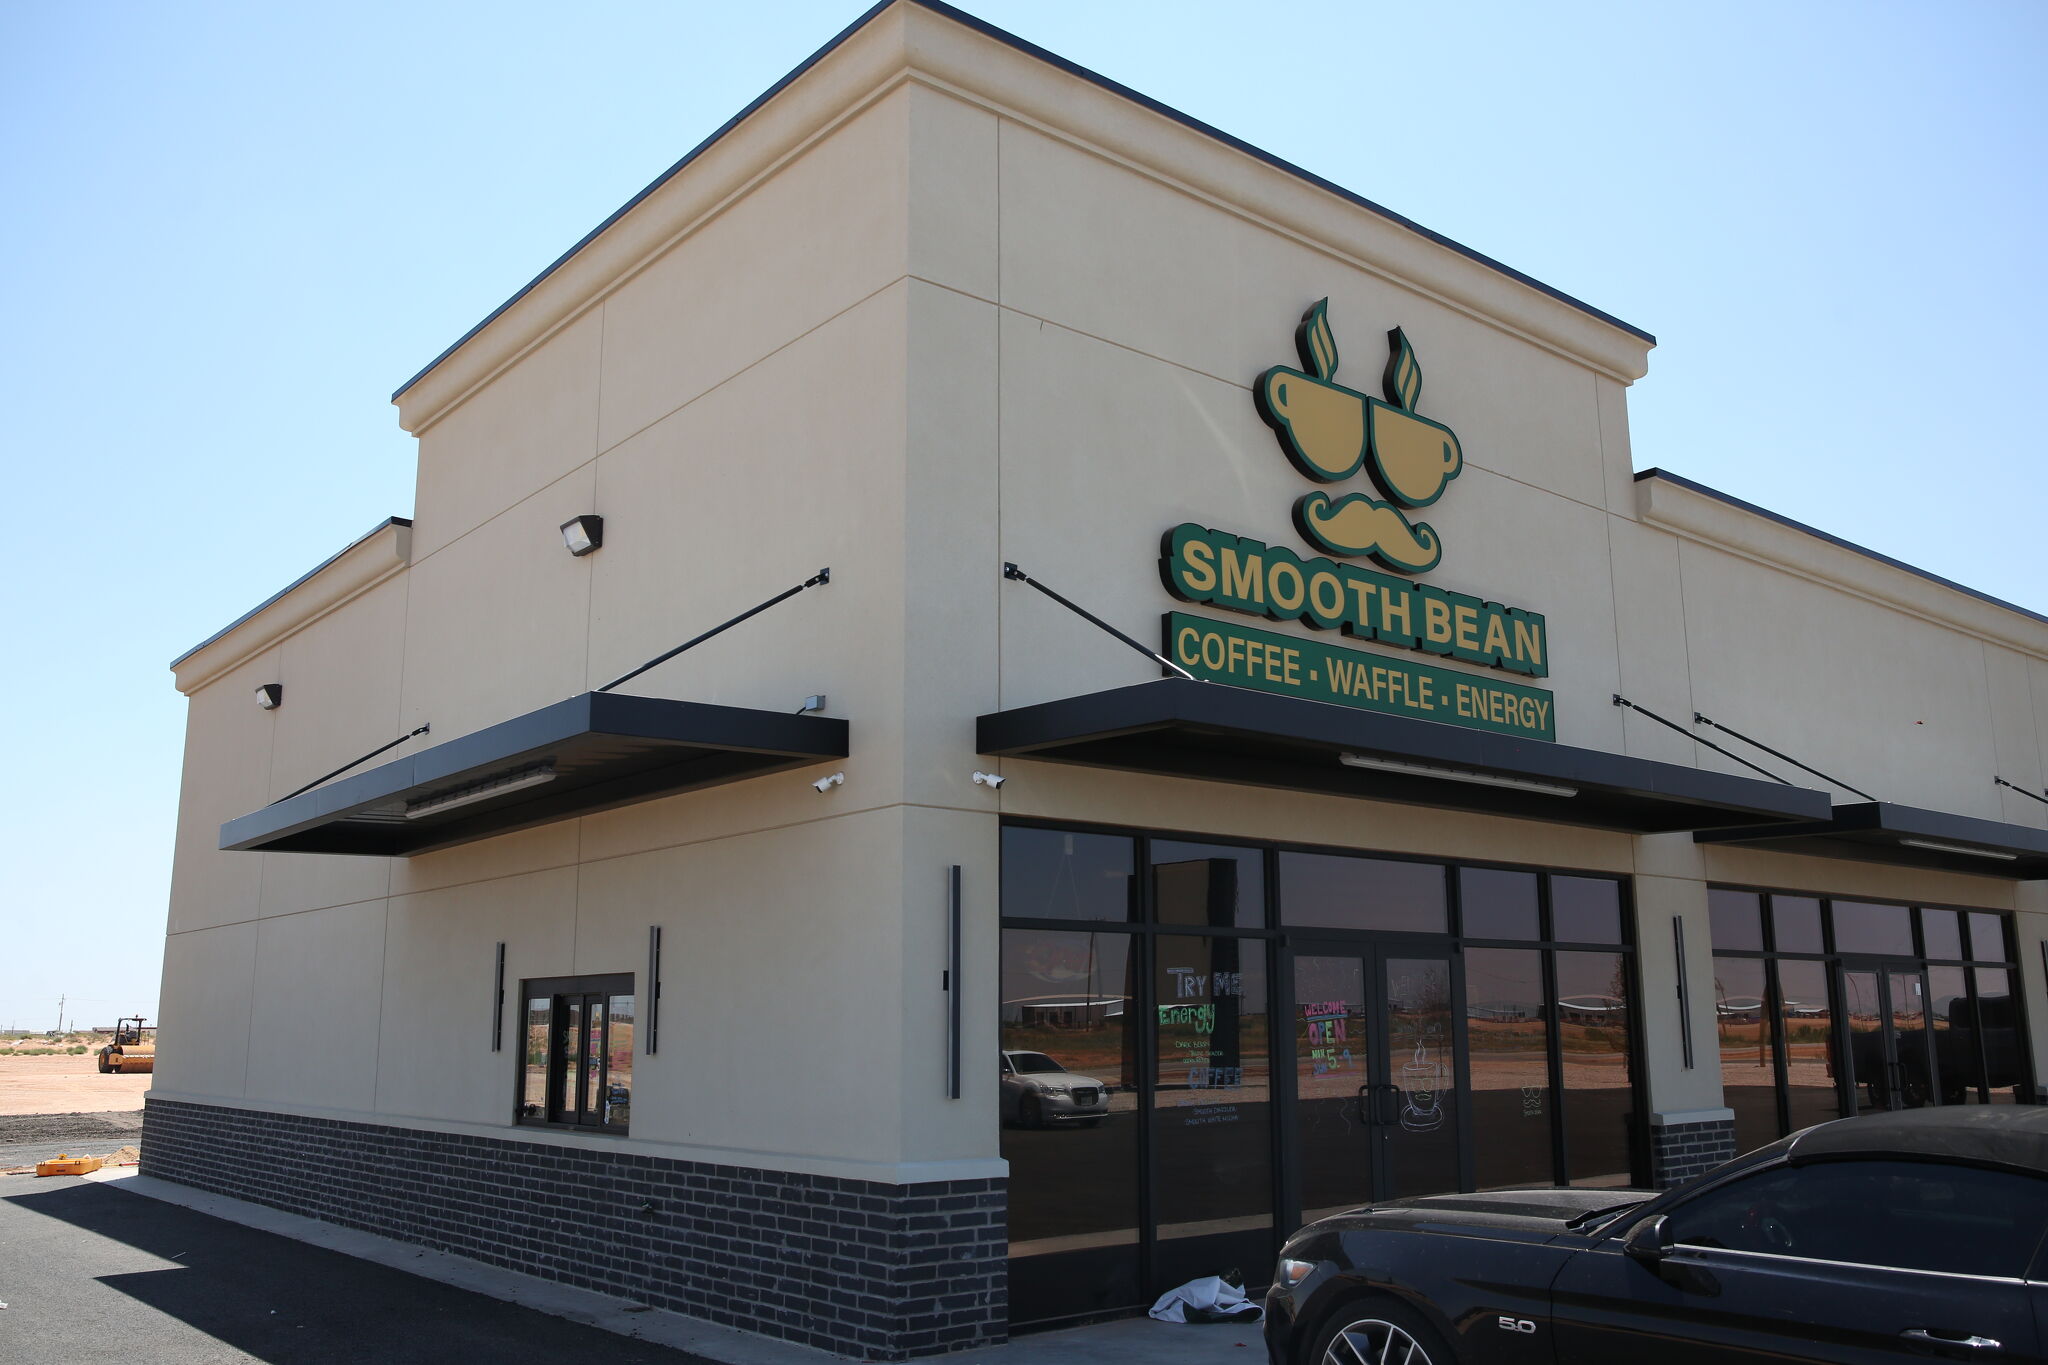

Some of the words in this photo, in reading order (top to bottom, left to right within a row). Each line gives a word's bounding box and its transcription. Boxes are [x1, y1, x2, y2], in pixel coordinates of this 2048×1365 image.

[1181, 539, 1411, 637] SMOOTH
[1424, 597, 1542, 665] BEAN
[1178, 627, 1301, 686] COFFEE
[1326, 657, 1435, 710] WAFFLE
[1456, 684, 1549, 730] ENERGY
[1158, 1004, 1216, 1034] Energy
[1304, 1000, 1347, 1017] WELCOME
[1308, 1018, 1347, 1045] OPEN
[1498, 1315, 1537, 1334] 5.0
